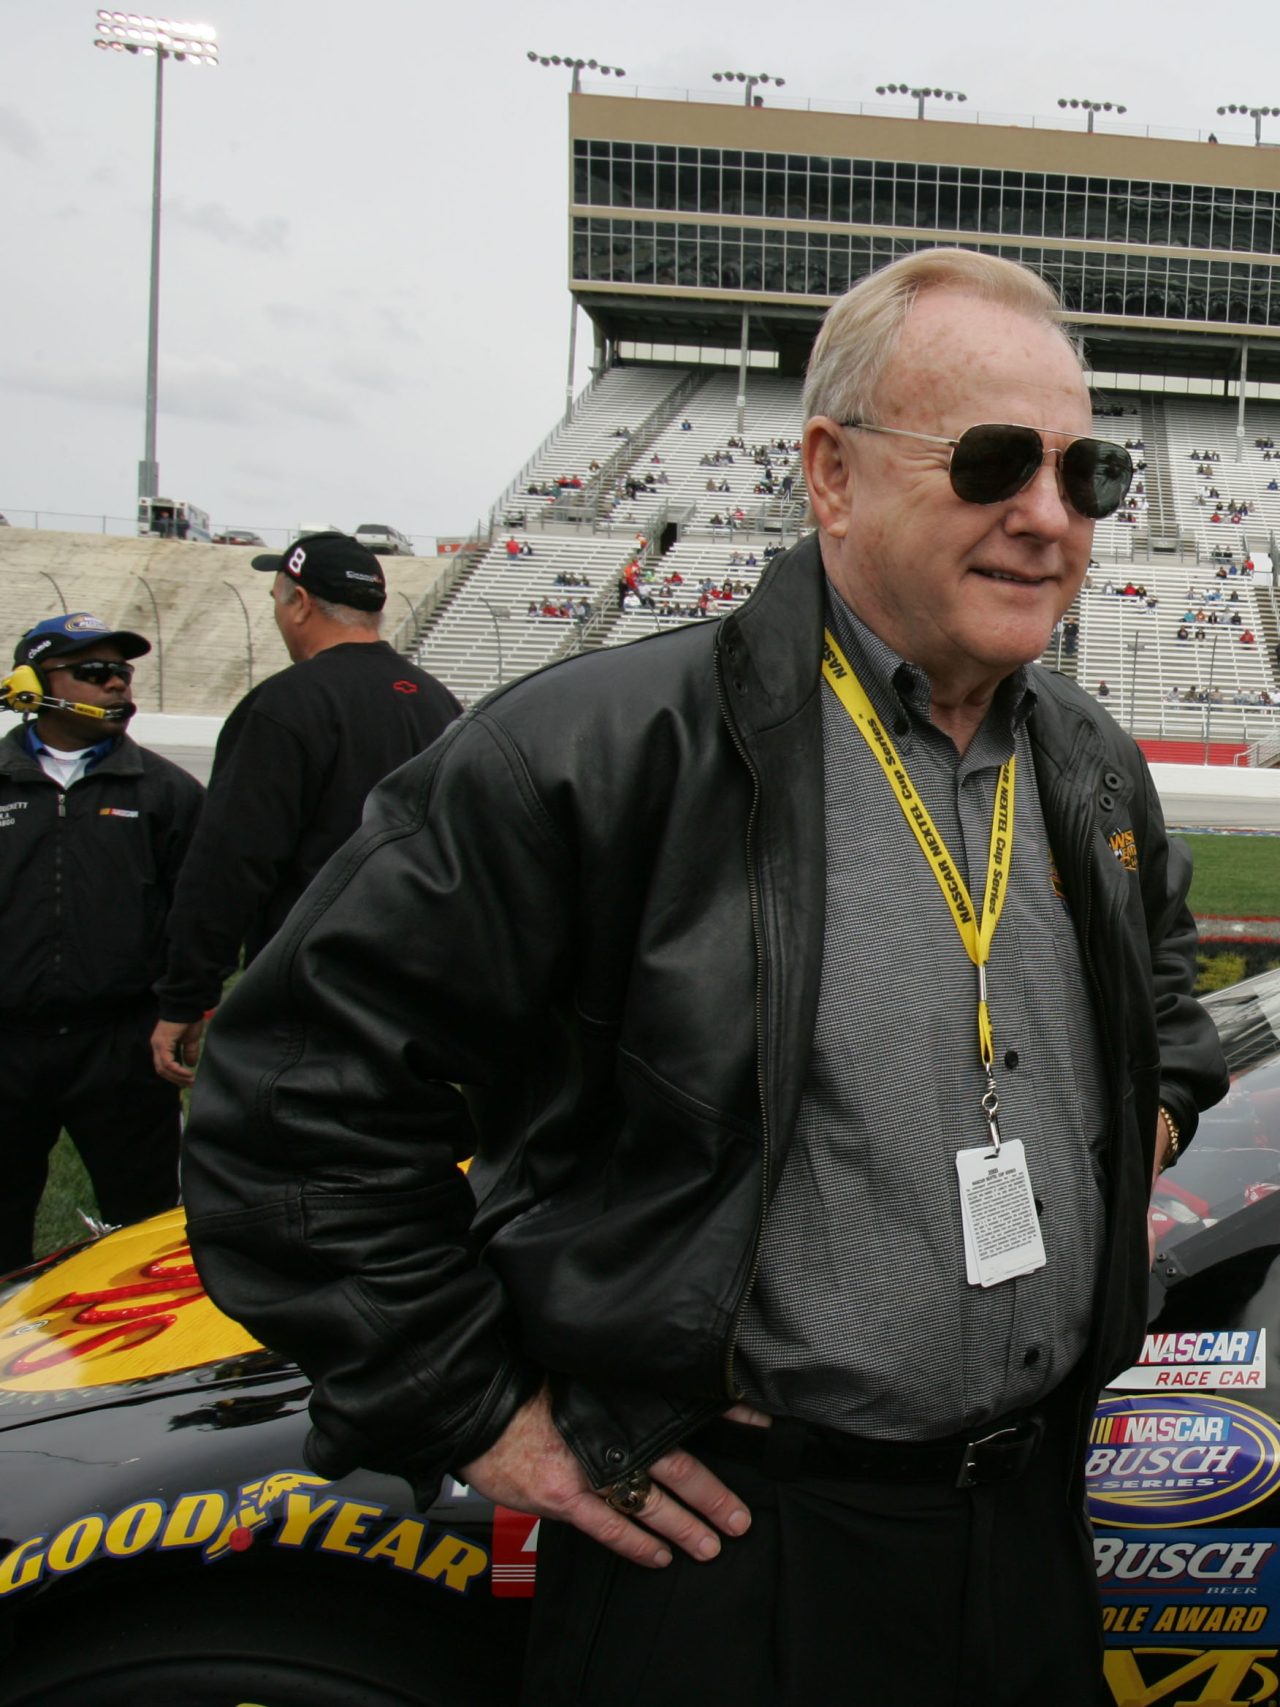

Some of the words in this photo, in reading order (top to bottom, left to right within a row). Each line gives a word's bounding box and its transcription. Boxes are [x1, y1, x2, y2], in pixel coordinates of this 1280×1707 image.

[288, 547, 306, 575] 8
[865, 717, 897, 769] Series
[893, 770, 913, 801] Cup
[997, 787, 1010, 833] NEXTEL
[910, 801, 943, 858] NEXTEL
[993, 838, 1007, 866] Cup
[937, 861, 972, 924] NASCAR
[987, 868, 1004, 916] Series
[1138, 1332, 1249, 1364] NASCAR
[1156, 1371, 1211, 1386] RACE
[1219, 1370, 1260, 1385] CAR
[1124, 1417, 1224, 1443] NASCAR
[1085, 1446, 1242, 1476] BUSCH
[1102, 1478, 1216, 1489] SERIES
[1093, 1538, 1273, 1579] BUSCH
[1103, 1606, 1150, 1632] OLE
[1152, 1607, 1267, 1632] AWARD
